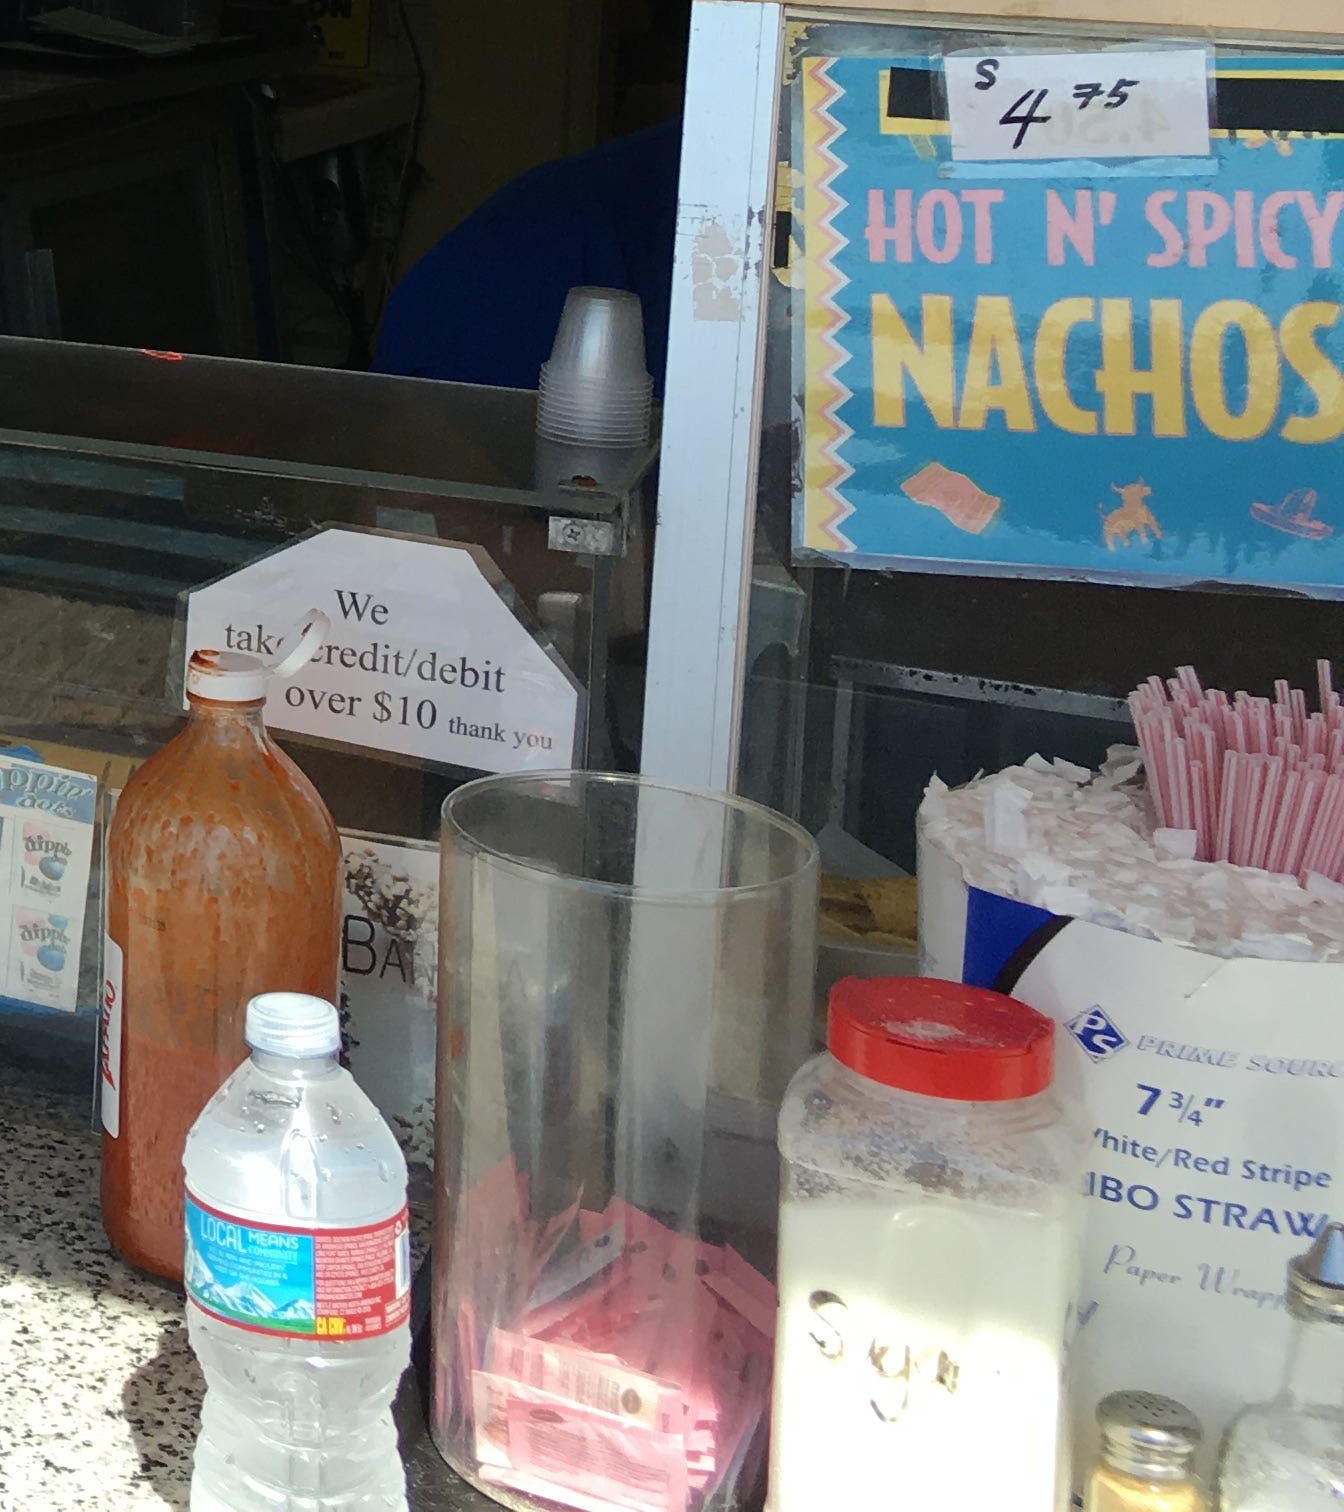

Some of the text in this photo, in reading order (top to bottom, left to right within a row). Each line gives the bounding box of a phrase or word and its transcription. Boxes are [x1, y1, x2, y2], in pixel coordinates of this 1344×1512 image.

[865, 188, 1005, 265] HOT
[1145, 190, 1344, 270] SPICY
[870, 292, 1344, 444] NACHOS
[335, 589, 389, 625] We
[225, 624, 284, 655] tak
[285, 685, 553, 750] over $10 thank you
[1136, 1035, 1238, 1068] PRIME
[1241, 1160, 1332, 1191] Stripe
[201, 1214, 299, 1253] LOCAL MEANS
[1103, 1243, 1181, 1286] Paper
